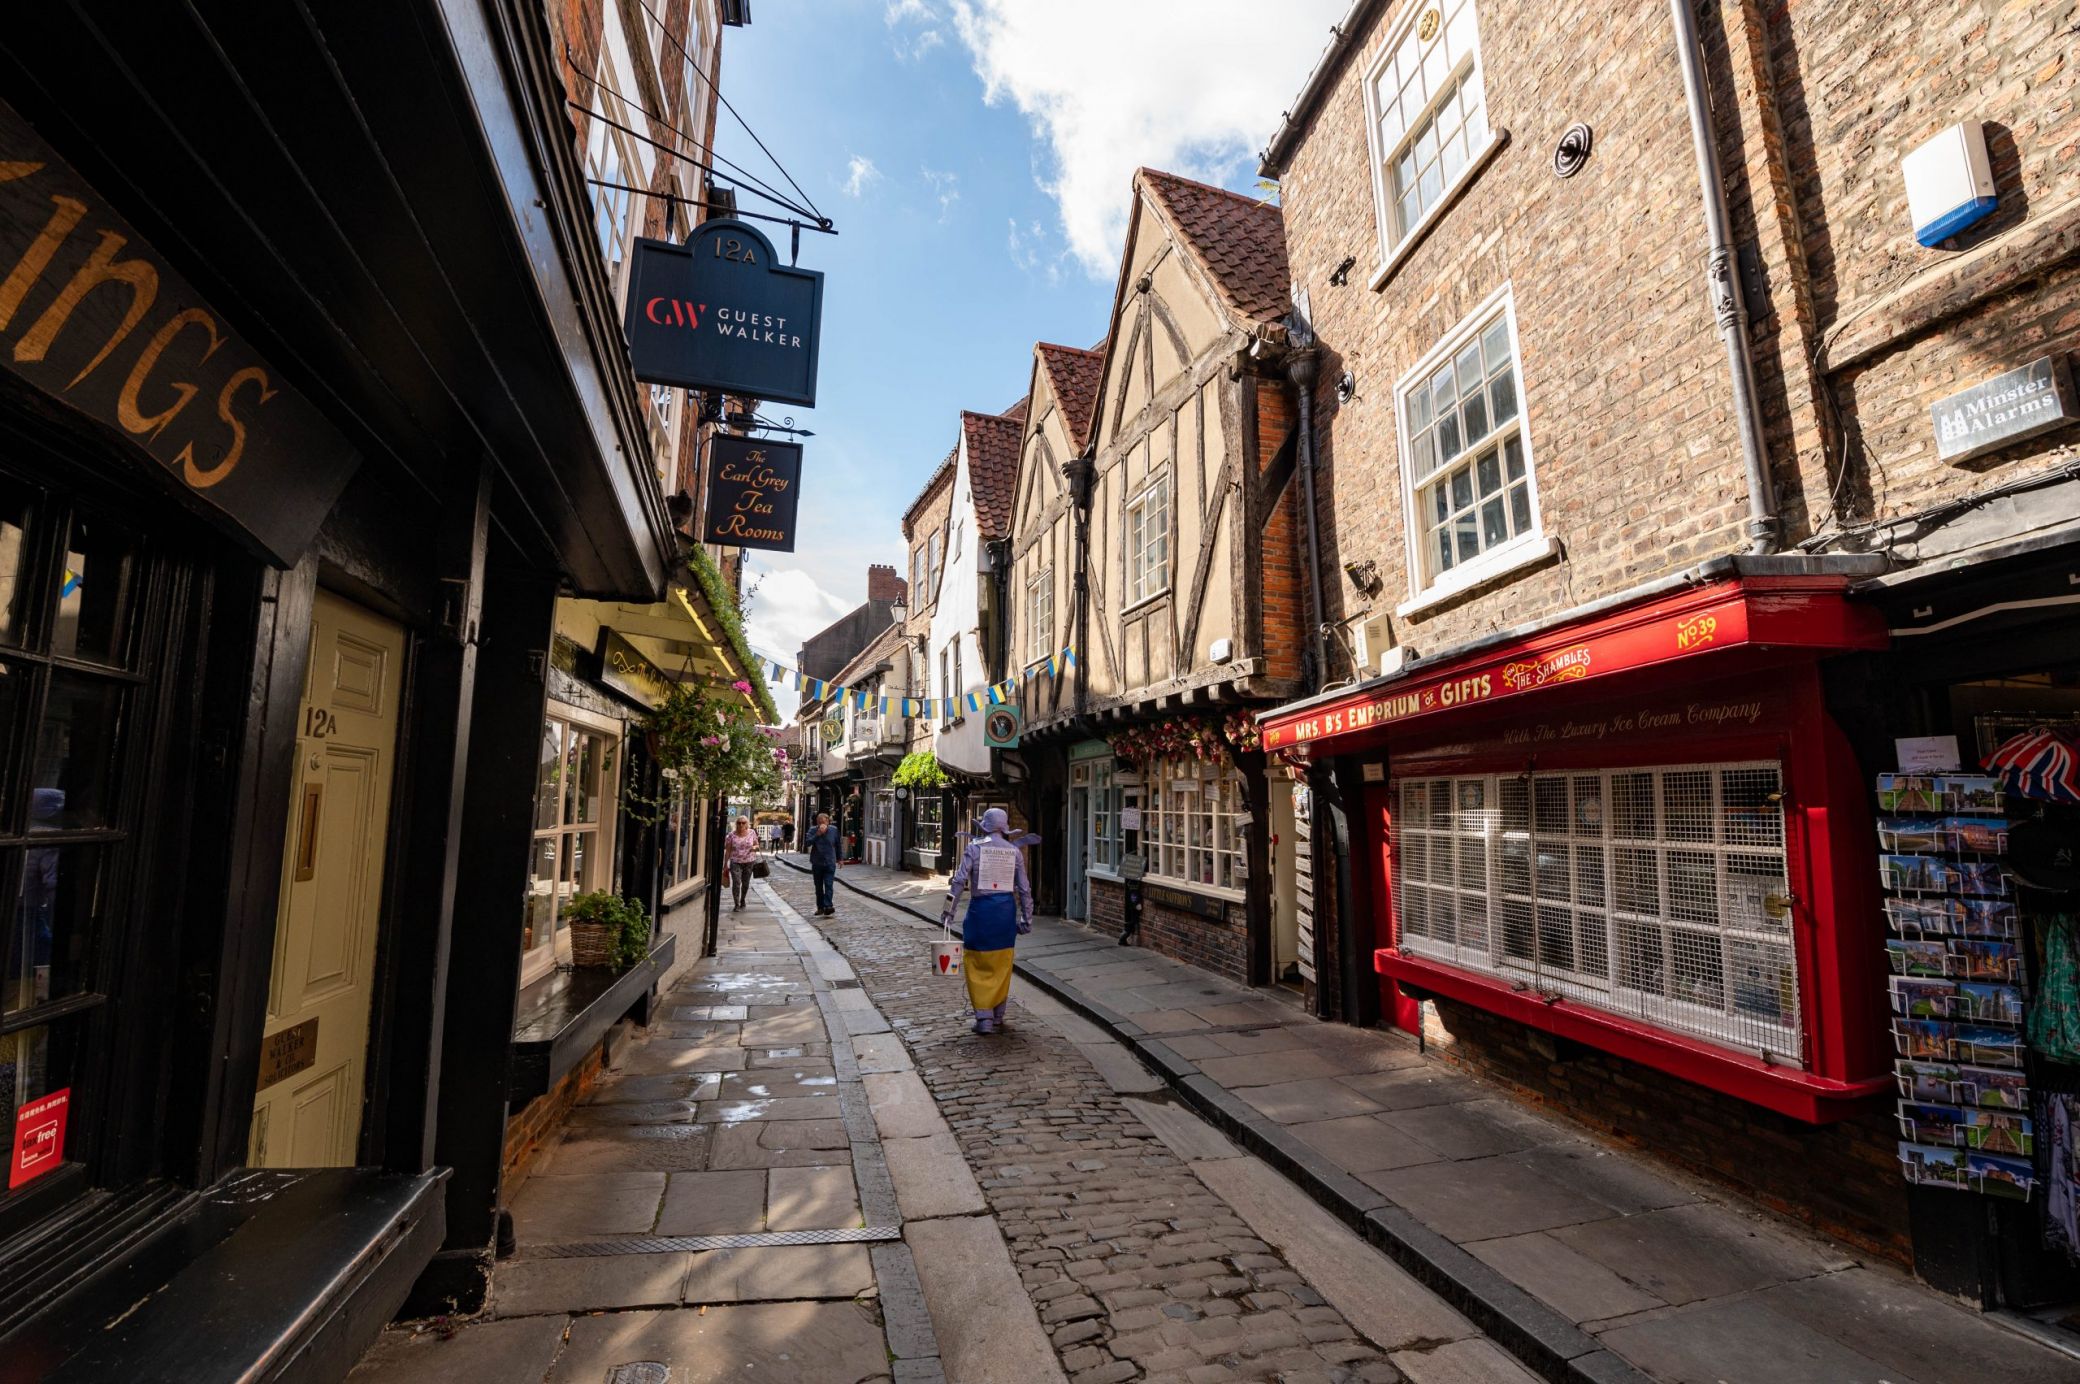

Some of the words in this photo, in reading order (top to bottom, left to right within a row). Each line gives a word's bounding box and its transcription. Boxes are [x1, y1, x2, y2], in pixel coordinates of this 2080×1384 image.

[715, 237, 757, 265] 12A
[717, 308, 787, 329] GUEST
[717, 322, 801, 348] WALKER
[1965, 376, 2048, 417] Minster
[1971, 394, 2054, 434] Alarms
[746, 450, 767, 463] The
[720, 463, 760, 483] Earl
[752, 468, 789, 492] Grey
[735, 490, 774, 514] Tea
[715, 514, 785, 541] Rooms
[1513, 671, 1531, 690] THE
[1536, 648, 1591, 684] SHAMBLES
[305, 706, 337, 738] 12A
[1295, 720, 1321, 741] MRS.
[1325, 713, 1342, 734] B'S
[1348, 693, 1420, 728] EMPORIUM
[1425, 693, 1434, 705] OF
[1441, 674, 1492, 706] GIFTS
[1533, 724, 1556, 742] The
[1561, 720, 1607, 740] Luxury
[1609, 714, 1634, 733] Ice
[1638, 709, 1681, 729] Cream
[1687, 702, 1761, 725] Company
